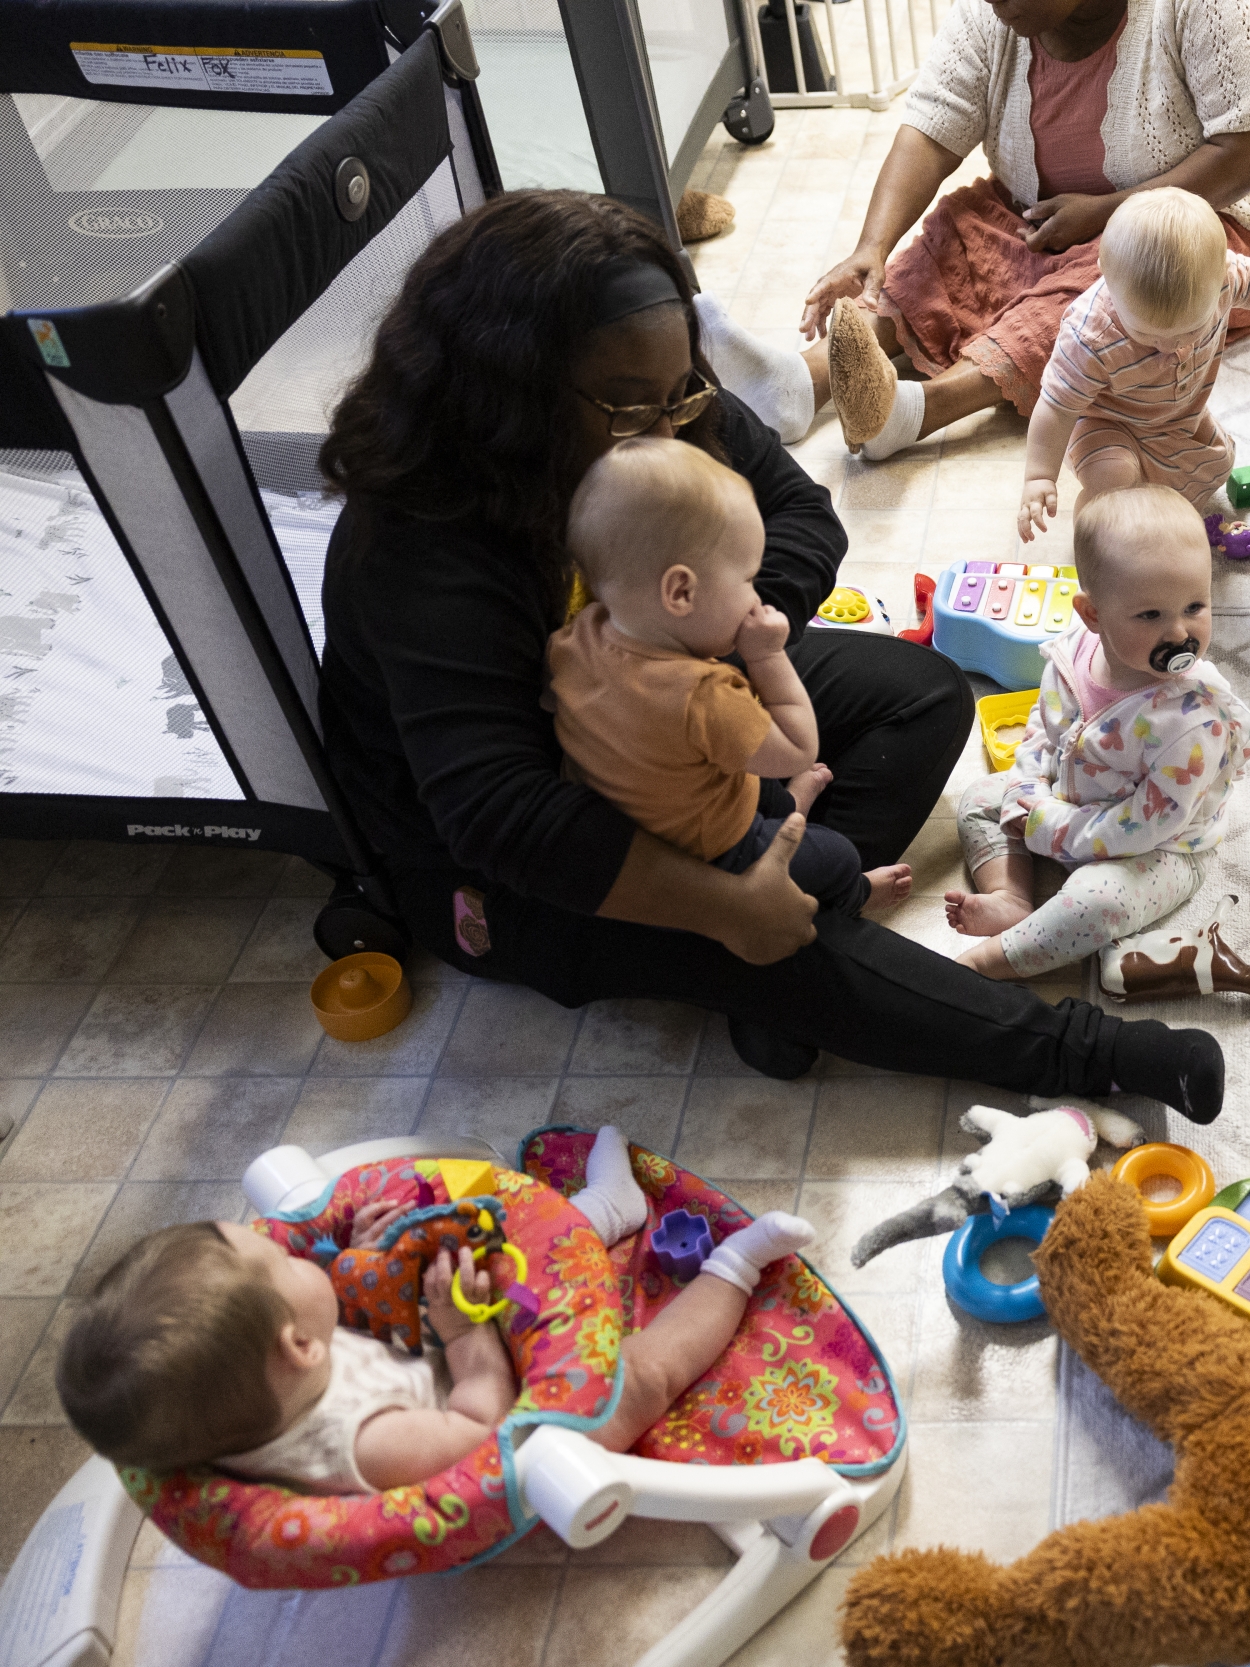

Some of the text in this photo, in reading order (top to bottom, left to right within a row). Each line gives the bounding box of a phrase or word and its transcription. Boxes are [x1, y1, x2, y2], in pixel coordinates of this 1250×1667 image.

[122, 45, 153, 53] WARNING
[143, 53, 192, 74] Felix
[81, 215, 154, 229] GRACO
[126, 824, 191, 836] Pack
[203, 825, 262, 841] Play
